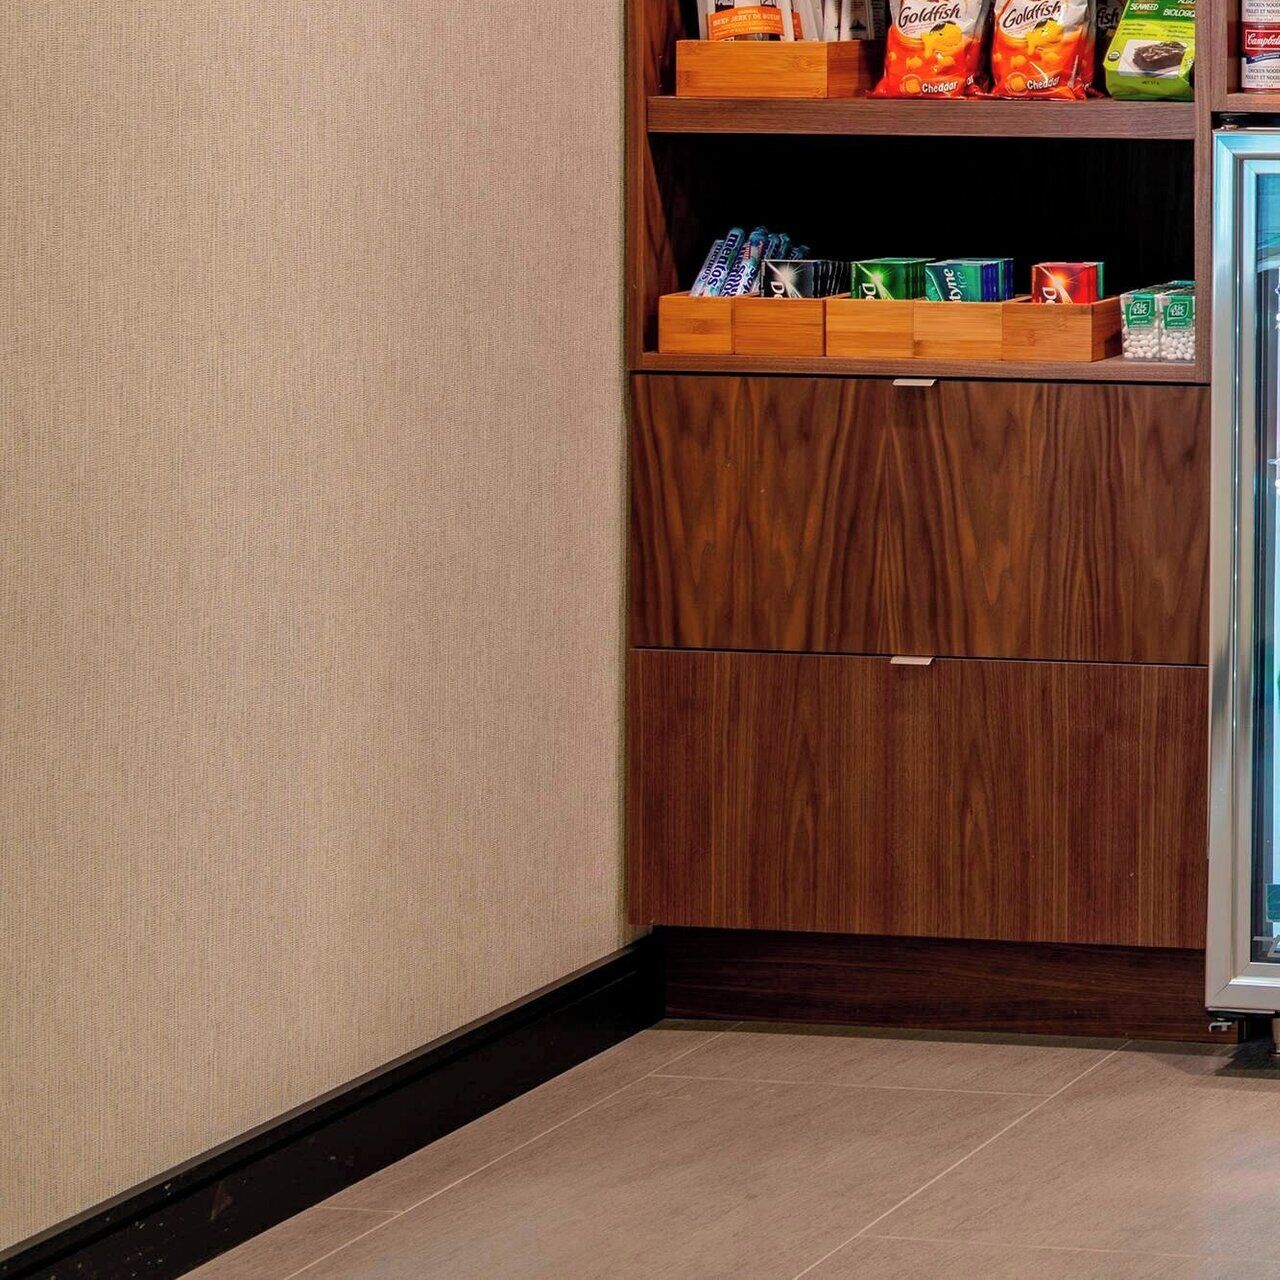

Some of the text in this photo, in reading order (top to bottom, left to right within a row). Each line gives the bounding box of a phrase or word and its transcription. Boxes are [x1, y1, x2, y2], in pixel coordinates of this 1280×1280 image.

[900, 2, 961, 28] Goldfish
[1002, 0, 1062, 29] Goldfish
[1130, 3, 1159, 11] SEAWEED
[922, 79, 958, 94] Cheddar
[1027, 76, 1060, 90] Cheddar
[707, 233, 740, 287] mentos
